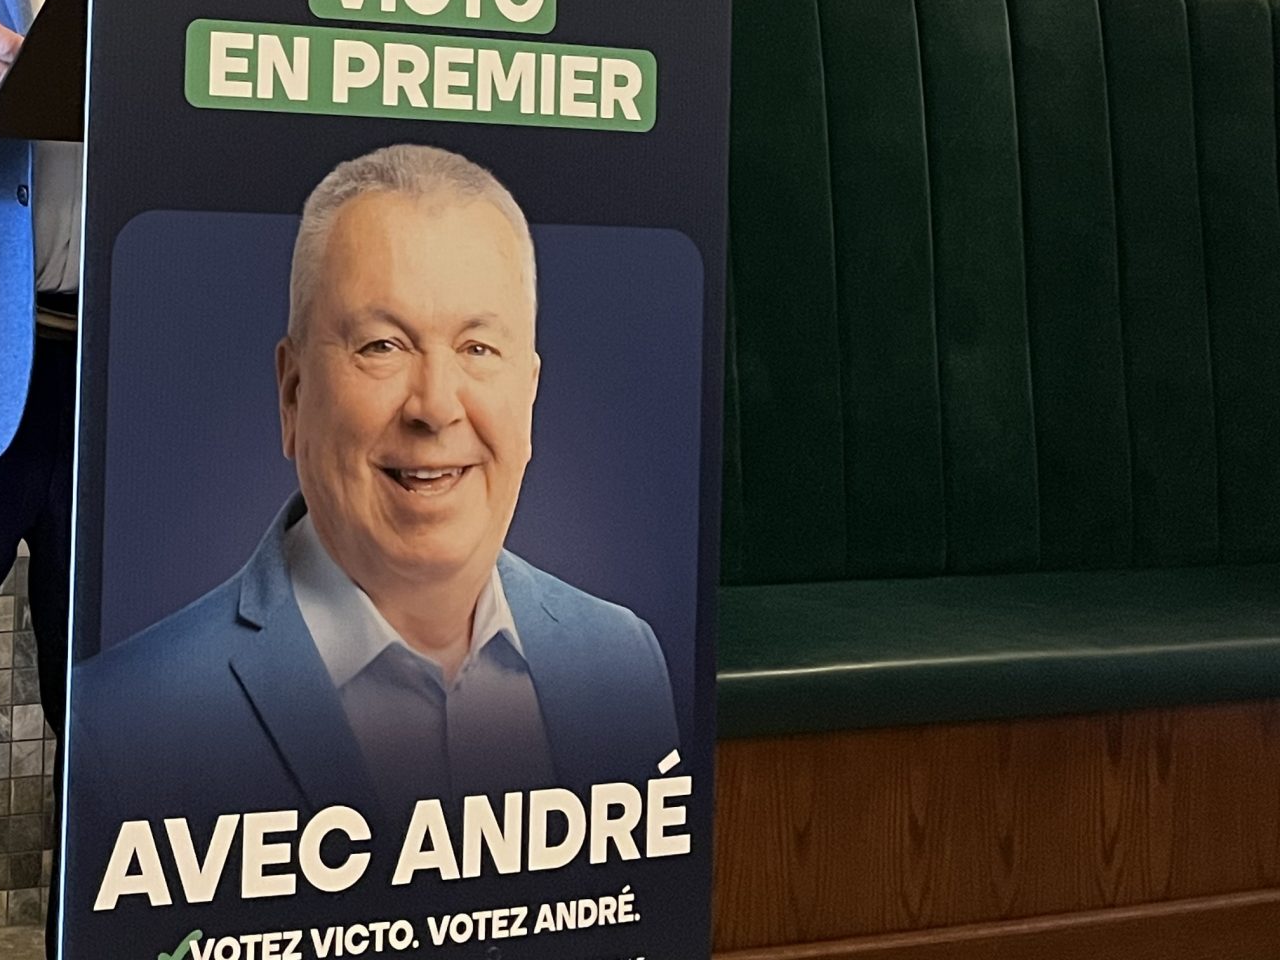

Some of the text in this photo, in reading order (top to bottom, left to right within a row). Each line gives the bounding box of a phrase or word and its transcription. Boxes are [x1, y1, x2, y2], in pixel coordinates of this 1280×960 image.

[209, 31, 642, 121] EN PREMIER
[92, 748, 693, 912] AVEC ANDRÉ
[189, 885, 641, 960] VOTEZ VICTO. VOTEZ ANDRÉ.
